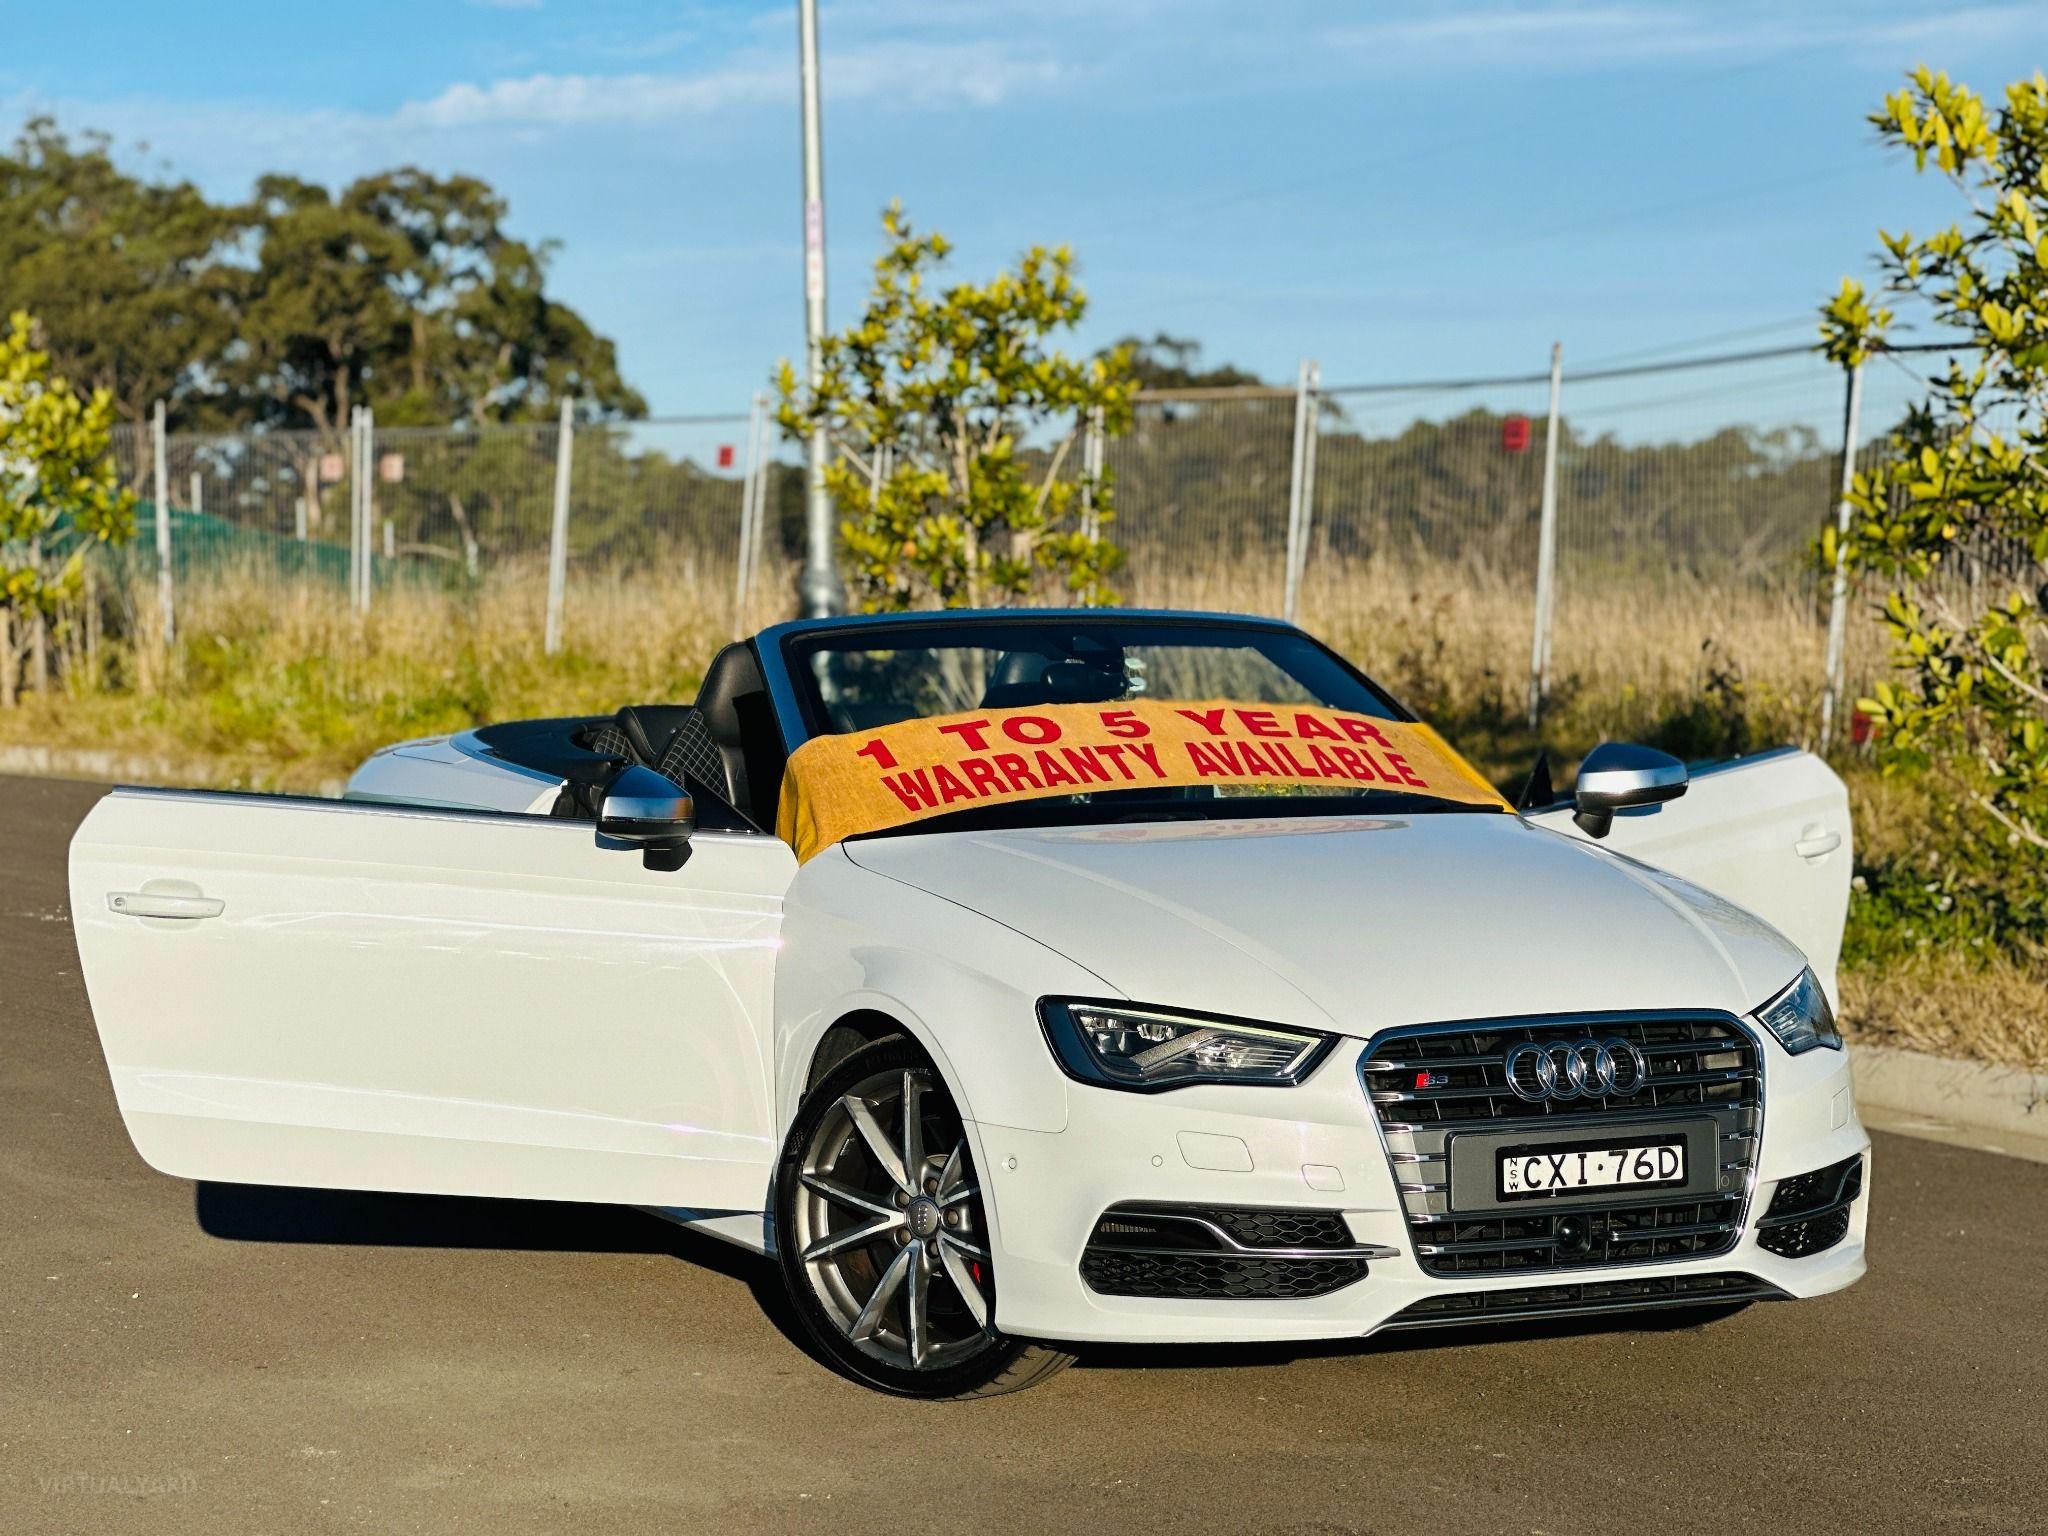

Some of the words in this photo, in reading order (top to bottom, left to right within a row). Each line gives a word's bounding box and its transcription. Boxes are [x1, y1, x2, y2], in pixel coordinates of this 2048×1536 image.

[856, 738, 899, 769] 1
[937, 715, 1062, 751] TO
[1099, 710, 1150, 738] 5
[1174, 708, 1394, 748] YEAR
[880, 743, 1168, 812] WARRANTY
[1184, 741, 1429, 788] AVAILABLE
